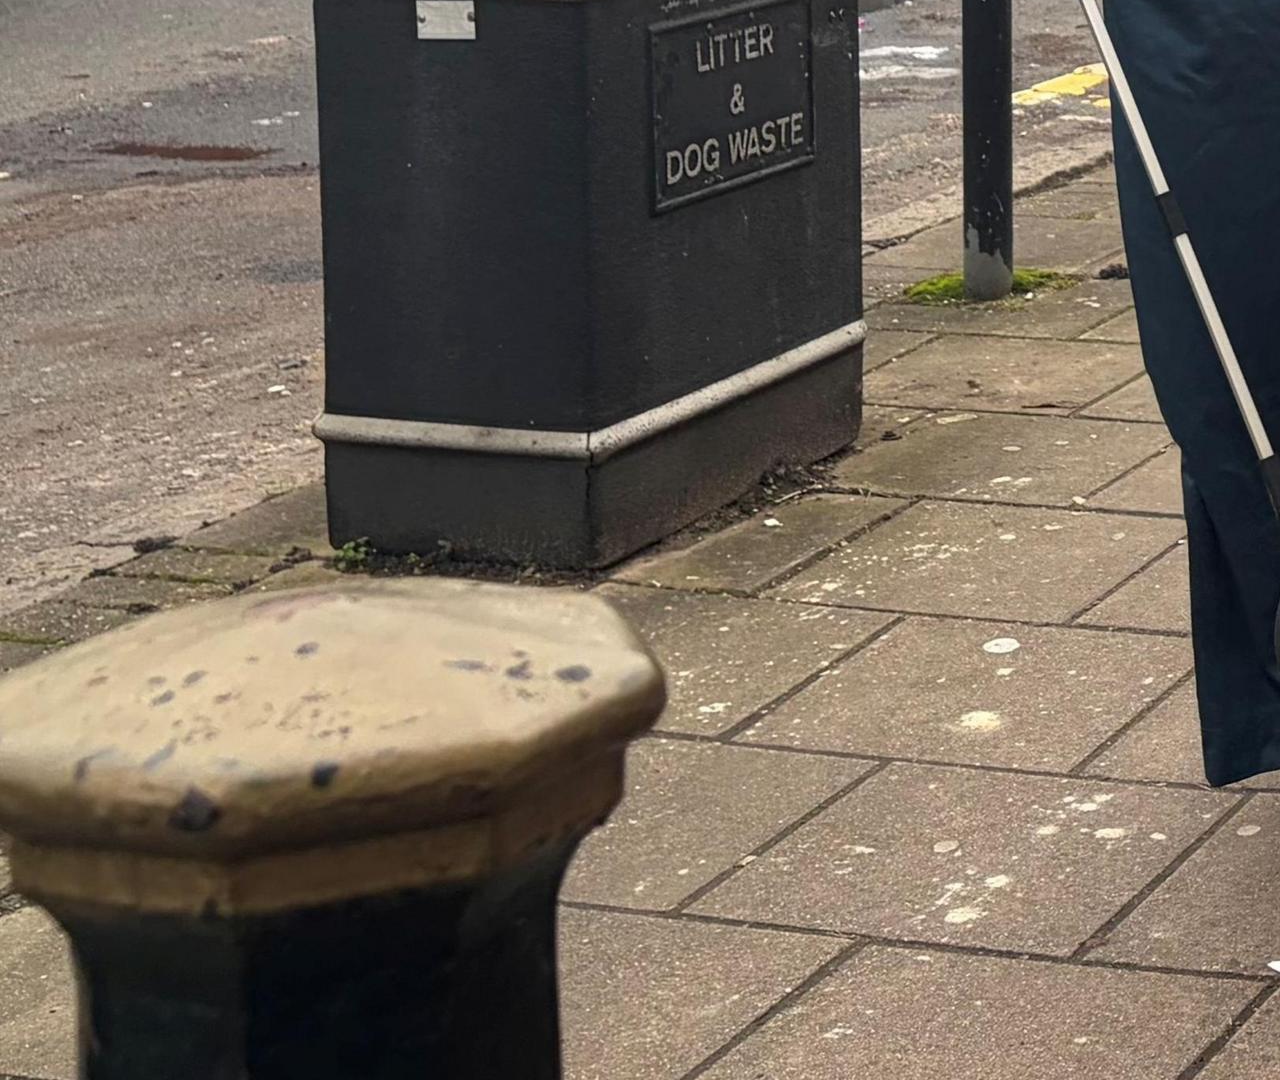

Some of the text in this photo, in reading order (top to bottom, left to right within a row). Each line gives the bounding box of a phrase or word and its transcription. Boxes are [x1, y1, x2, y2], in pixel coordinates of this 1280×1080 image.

[696, 24, 774, 72] LITTER
[730, 83, 745, 114] &
[667, 113, 803, 184] DOG WASTE
